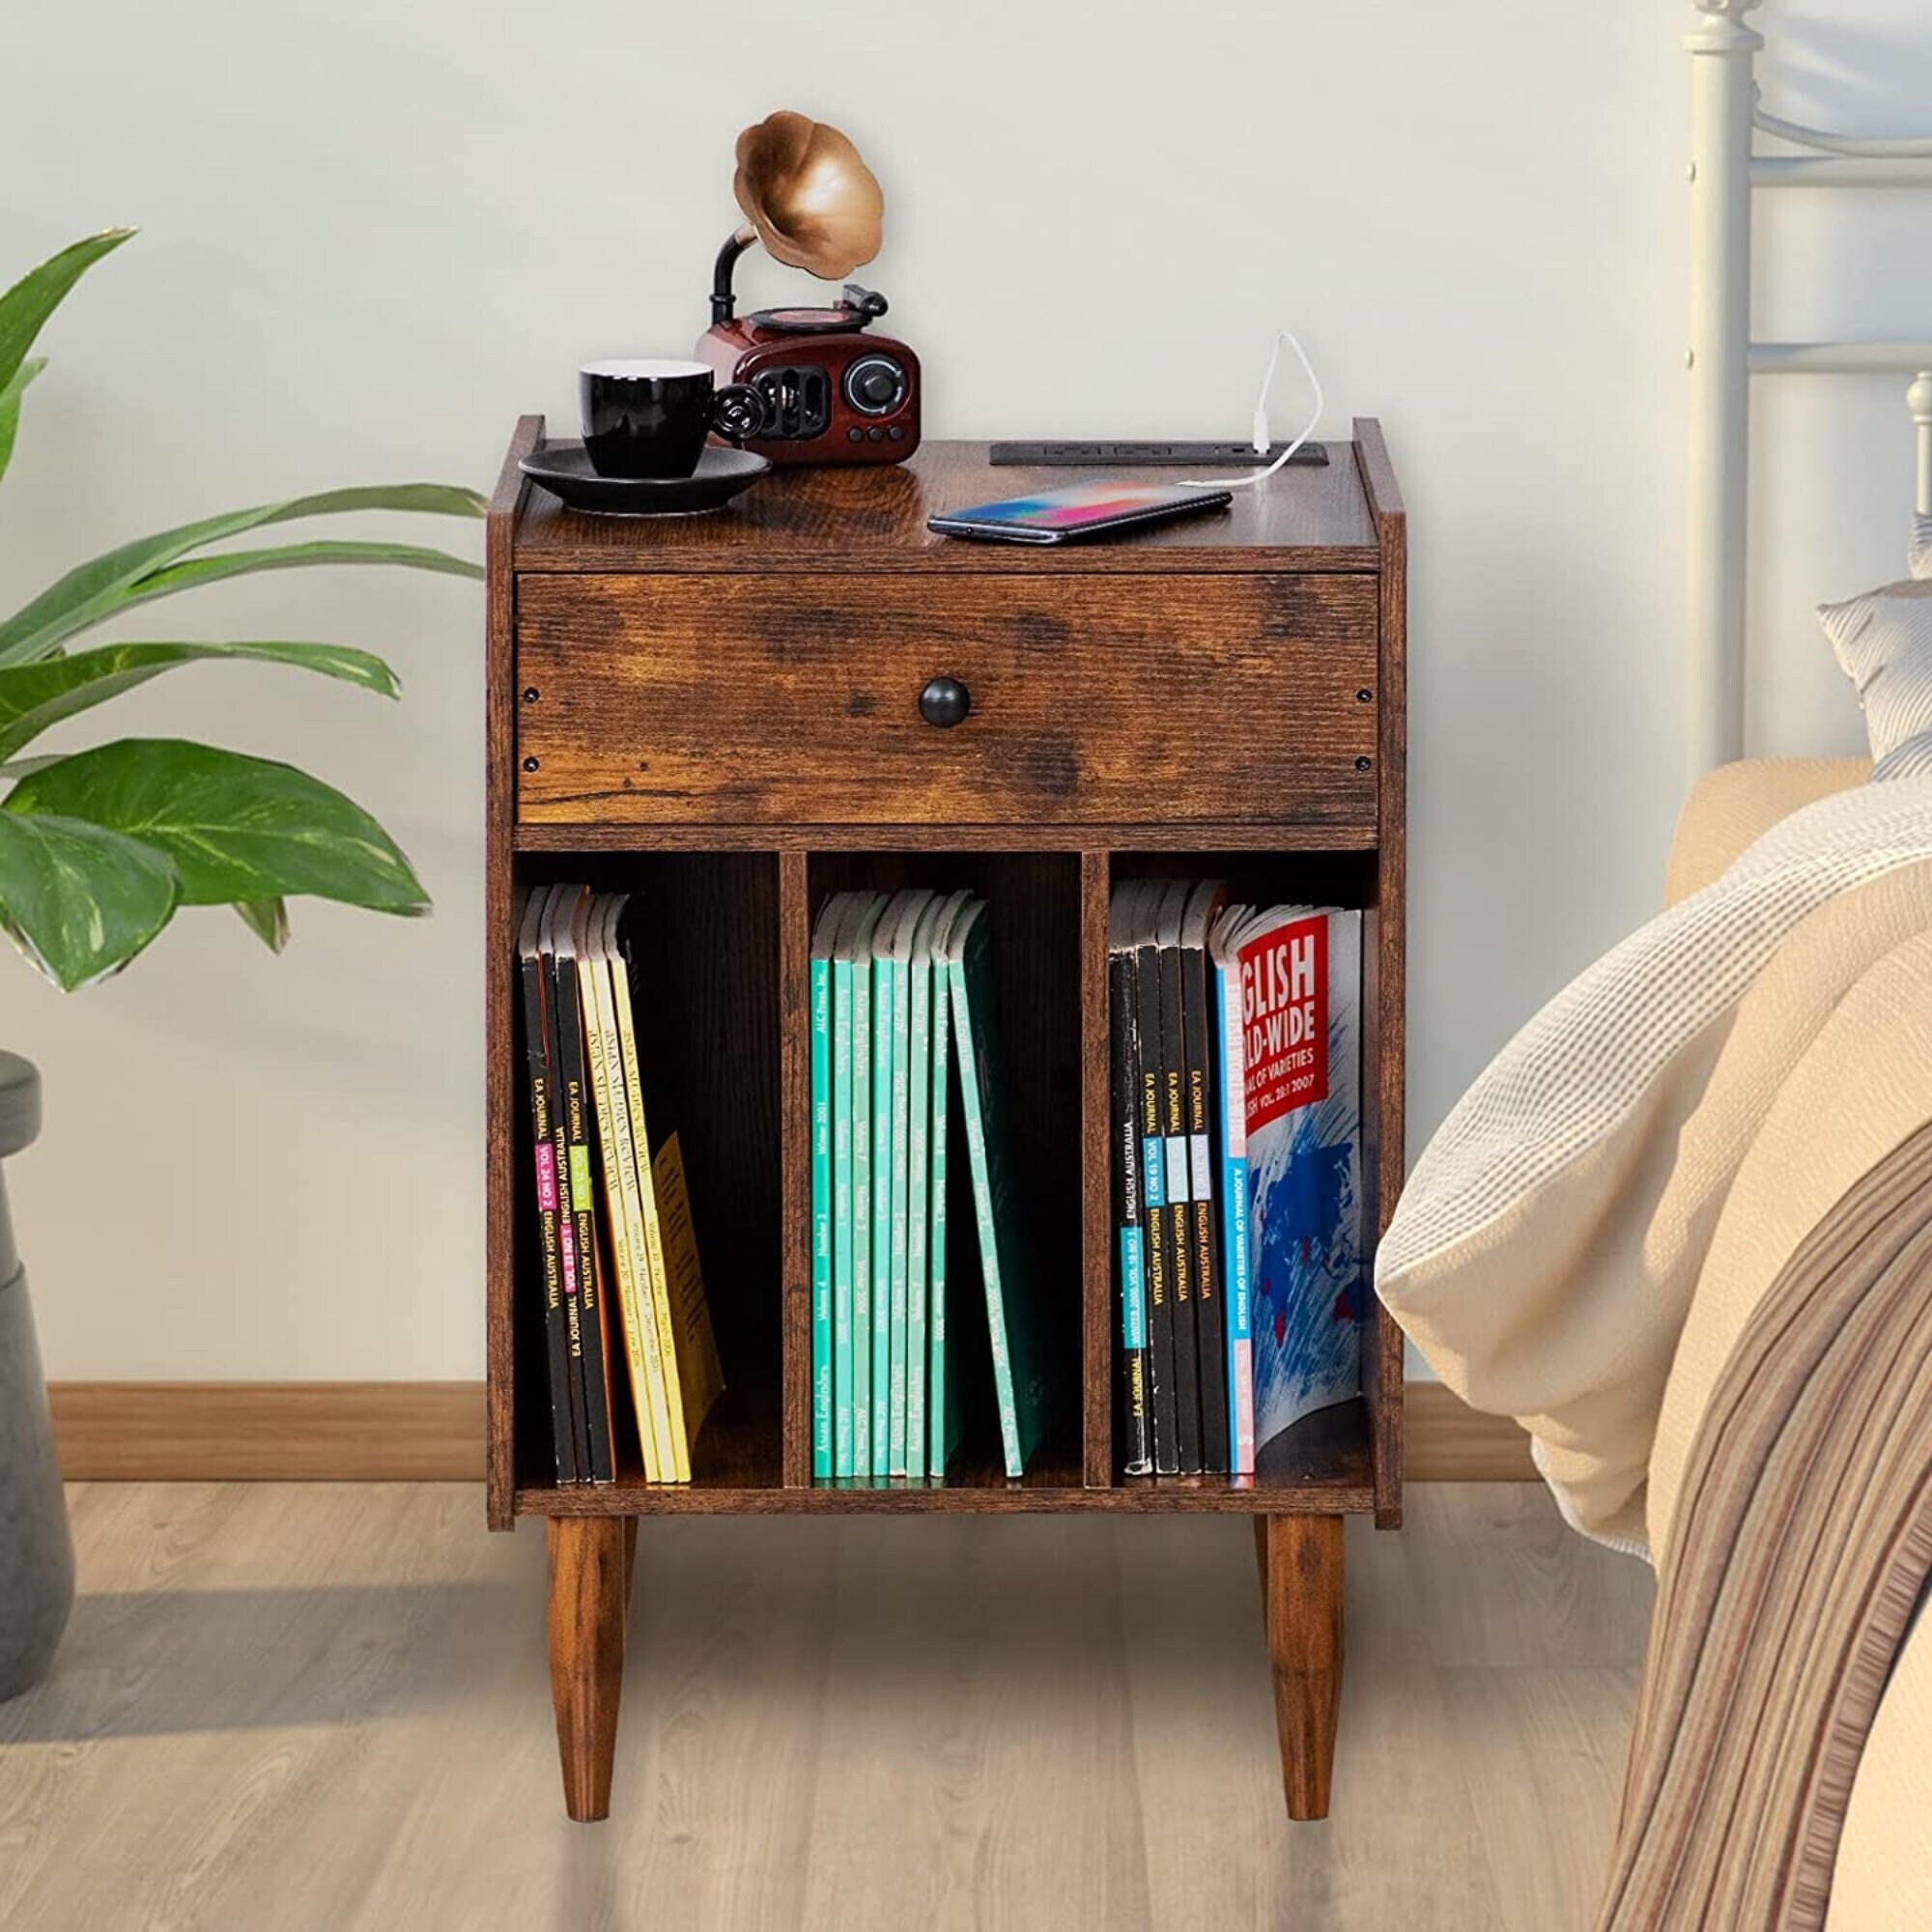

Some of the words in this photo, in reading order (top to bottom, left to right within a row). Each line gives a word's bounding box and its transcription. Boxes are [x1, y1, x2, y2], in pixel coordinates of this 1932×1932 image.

[838, 989, 850, 1018] Asian
[856, 990, 868, 1019] Asian
[935, 989, 948, 1019] Asian
[854, 1022, 868, 1076] Englishes
[1146, 1073, 1155, 1086] EA
[1169, 1073, 1179, 1086] EA
[1191, 1071, 1201, 1083] EA
[1256, 1067, 1266, 1088] OF
[1267, 1047, 1314, 1081] VARIETIES
[1292, 1073, 1314, 1093] 2007
[534, 1078, 544, 1092] EA
[570, 1082, 578, 1094] EA
[535, 1094, 547, 1140] JOURNAL
[571, 1097, 582, 1142] JOURNAL
[1146, 1090, 1157, 1134] JOURNAL
[1169, 1089, 1180, 1132] JOURNAL
[1193, 1087, 1203, 1129] JOURNAL
[555, 1126, 567, 1180] AUSTRALIA
[817, 1125, 827, 1154] Winter
[857, 1121, 866, 1154] Volume
[1124, 1121, 1135, 1175] AUSTRALIA
[1148, 1142, 1157, 1161] VOL
[542, 1170, 550, 1180] 24
[1149, 1164, 1157, 1175] 19
[1150, 1177, 1158, 1192] NO
[543, 1181, 551, 1198] NO
[560, 1183, 570, 1224] ENGLISH
[1126, 1179, 1136, 1218] ENGLISH
[1235, 1177, 1243, 1217] JOURNAL
[544, 1211, 554, 1251] ENGLISH
[579, 1213, 588, 1253] ENGLISH
[817, 1222, 827, 1256] Number
[1150, 1208, 1161, 1248] ENGLISH
[1175, 1206, 1184, 1244] ENGLISH
[1198, 1203, 1208, 1243] ENGLISH
[1236, 1219, 1243, 1232] OF
[563, 1237, 573, 1252] NO
[1128, 1238, 1138, 1252] NO
[1236, 1234, 1244, 1276] VARIETIES
[547, 1255, 558, 1308] AUSTRALIA
[565, 1269, 576, 1289] VOL
[582, 1256, 594, 1309] AUSTRALIA
[857, 1261, 866, 1290] Winter
[1129, 1267, 1138, 1287] VOL
[1152, 1251, 1163, 1304] AUSTRALIA
[1177, 1248, 1187, 1301] AUSTRALIA
[1200, 1246, 1210, 1299] AUSTRALIA
[1236, 1277, 1245, 1290] OF
[568, 1296, 580, 1340] JOURNAL
[817, 1290, 828, 1321] Volume
[1237, 1292, 1246, 1329] ENGLISH
[572, 1344, 581, 1356] EA
[816, 1365, 829, 1418] Englishes
[1132, 1358, 1143, 1401] JOURNAL
[1133, 1405, 1143, 1416] EA
[816, 1421, 829, 1453] Asian
[892, 1419, 904, 1449] Asian
[909, 1420, 923, 1451] Asian
